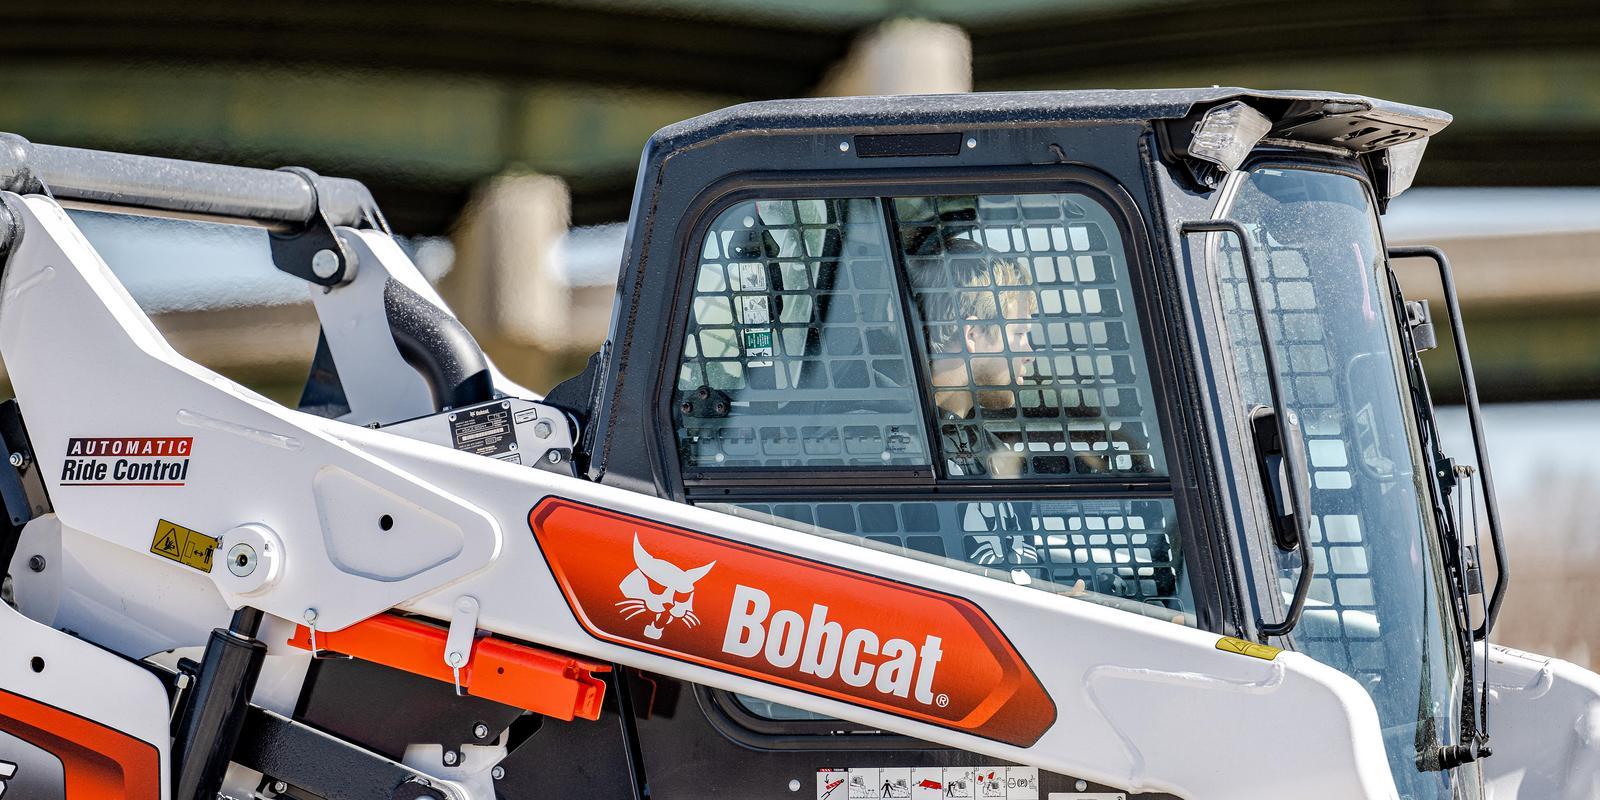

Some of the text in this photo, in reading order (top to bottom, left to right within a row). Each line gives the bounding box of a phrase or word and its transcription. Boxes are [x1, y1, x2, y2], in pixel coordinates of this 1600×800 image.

[71, 440, 188, 454] AUTOMATIC
[61, 459, 189, 481] Ride Control
[722, 584, 943, 706] Bobcat
